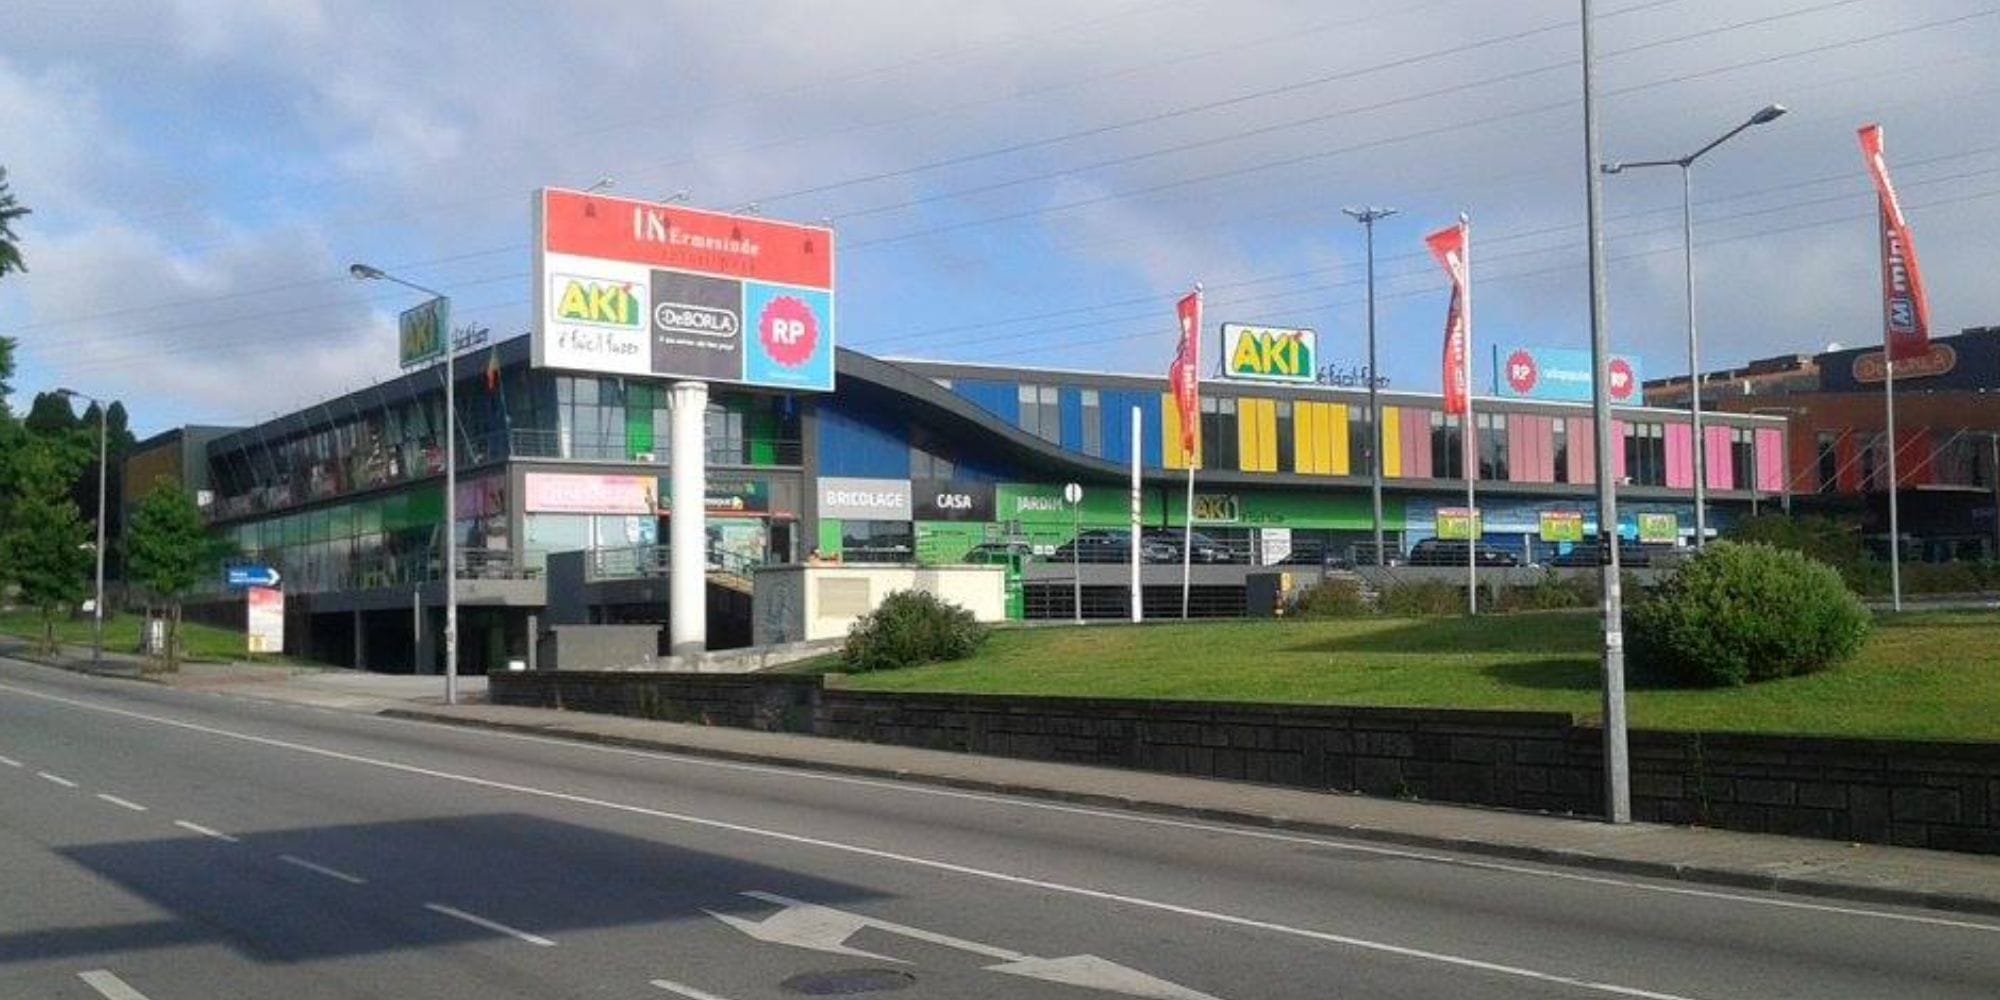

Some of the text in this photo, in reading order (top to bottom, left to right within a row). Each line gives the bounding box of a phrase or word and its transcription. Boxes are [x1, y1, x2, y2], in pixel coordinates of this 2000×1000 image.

[632, 205, 760, 255] IN Ermesinde
[771, 318, 806, 345] RP
[1232, 329, 1311, 377] AKI
[826, 490, 905, 510] BRICOLAGE
[936, 494, 973, 510] CASA
